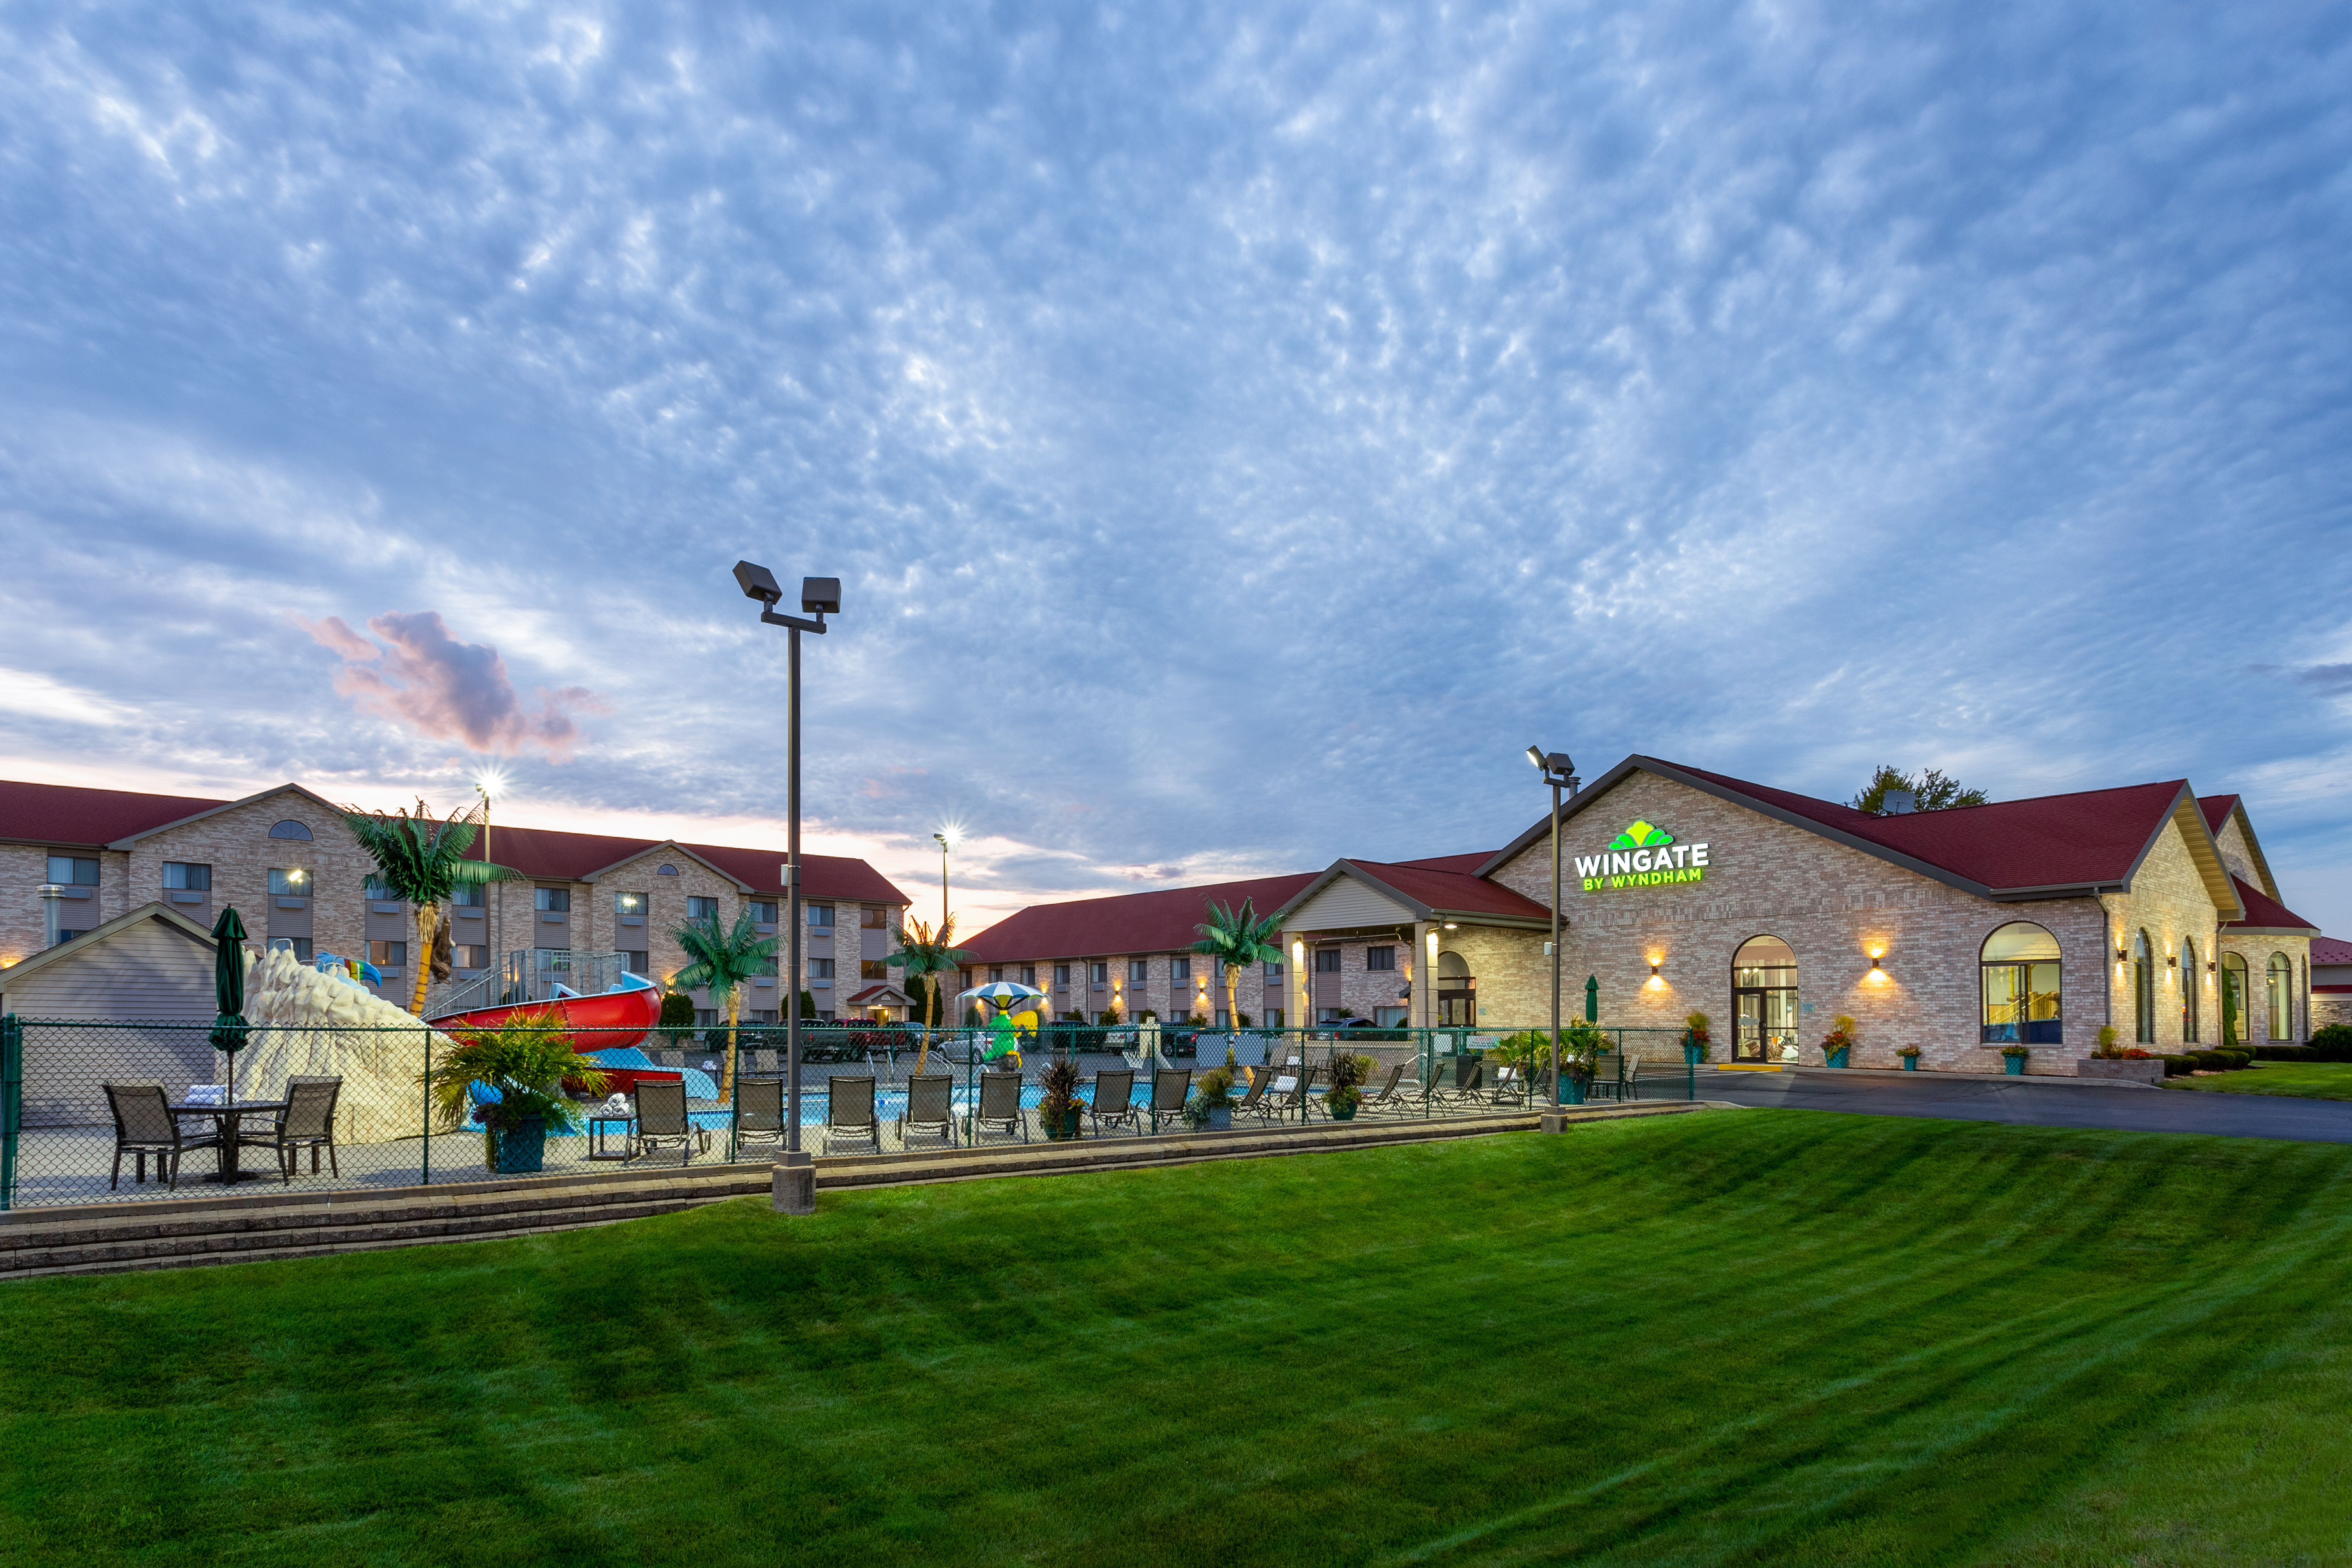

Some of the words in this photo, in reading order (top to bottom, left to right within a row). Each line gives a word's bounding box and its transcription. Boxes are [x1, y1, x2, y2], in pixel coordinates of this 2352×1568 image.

[1575, 843, 1709, 878] WINGATE
[1584, 878, 1604, 890] BY
[1612, 868, 1701, 887] WYNDHAM
